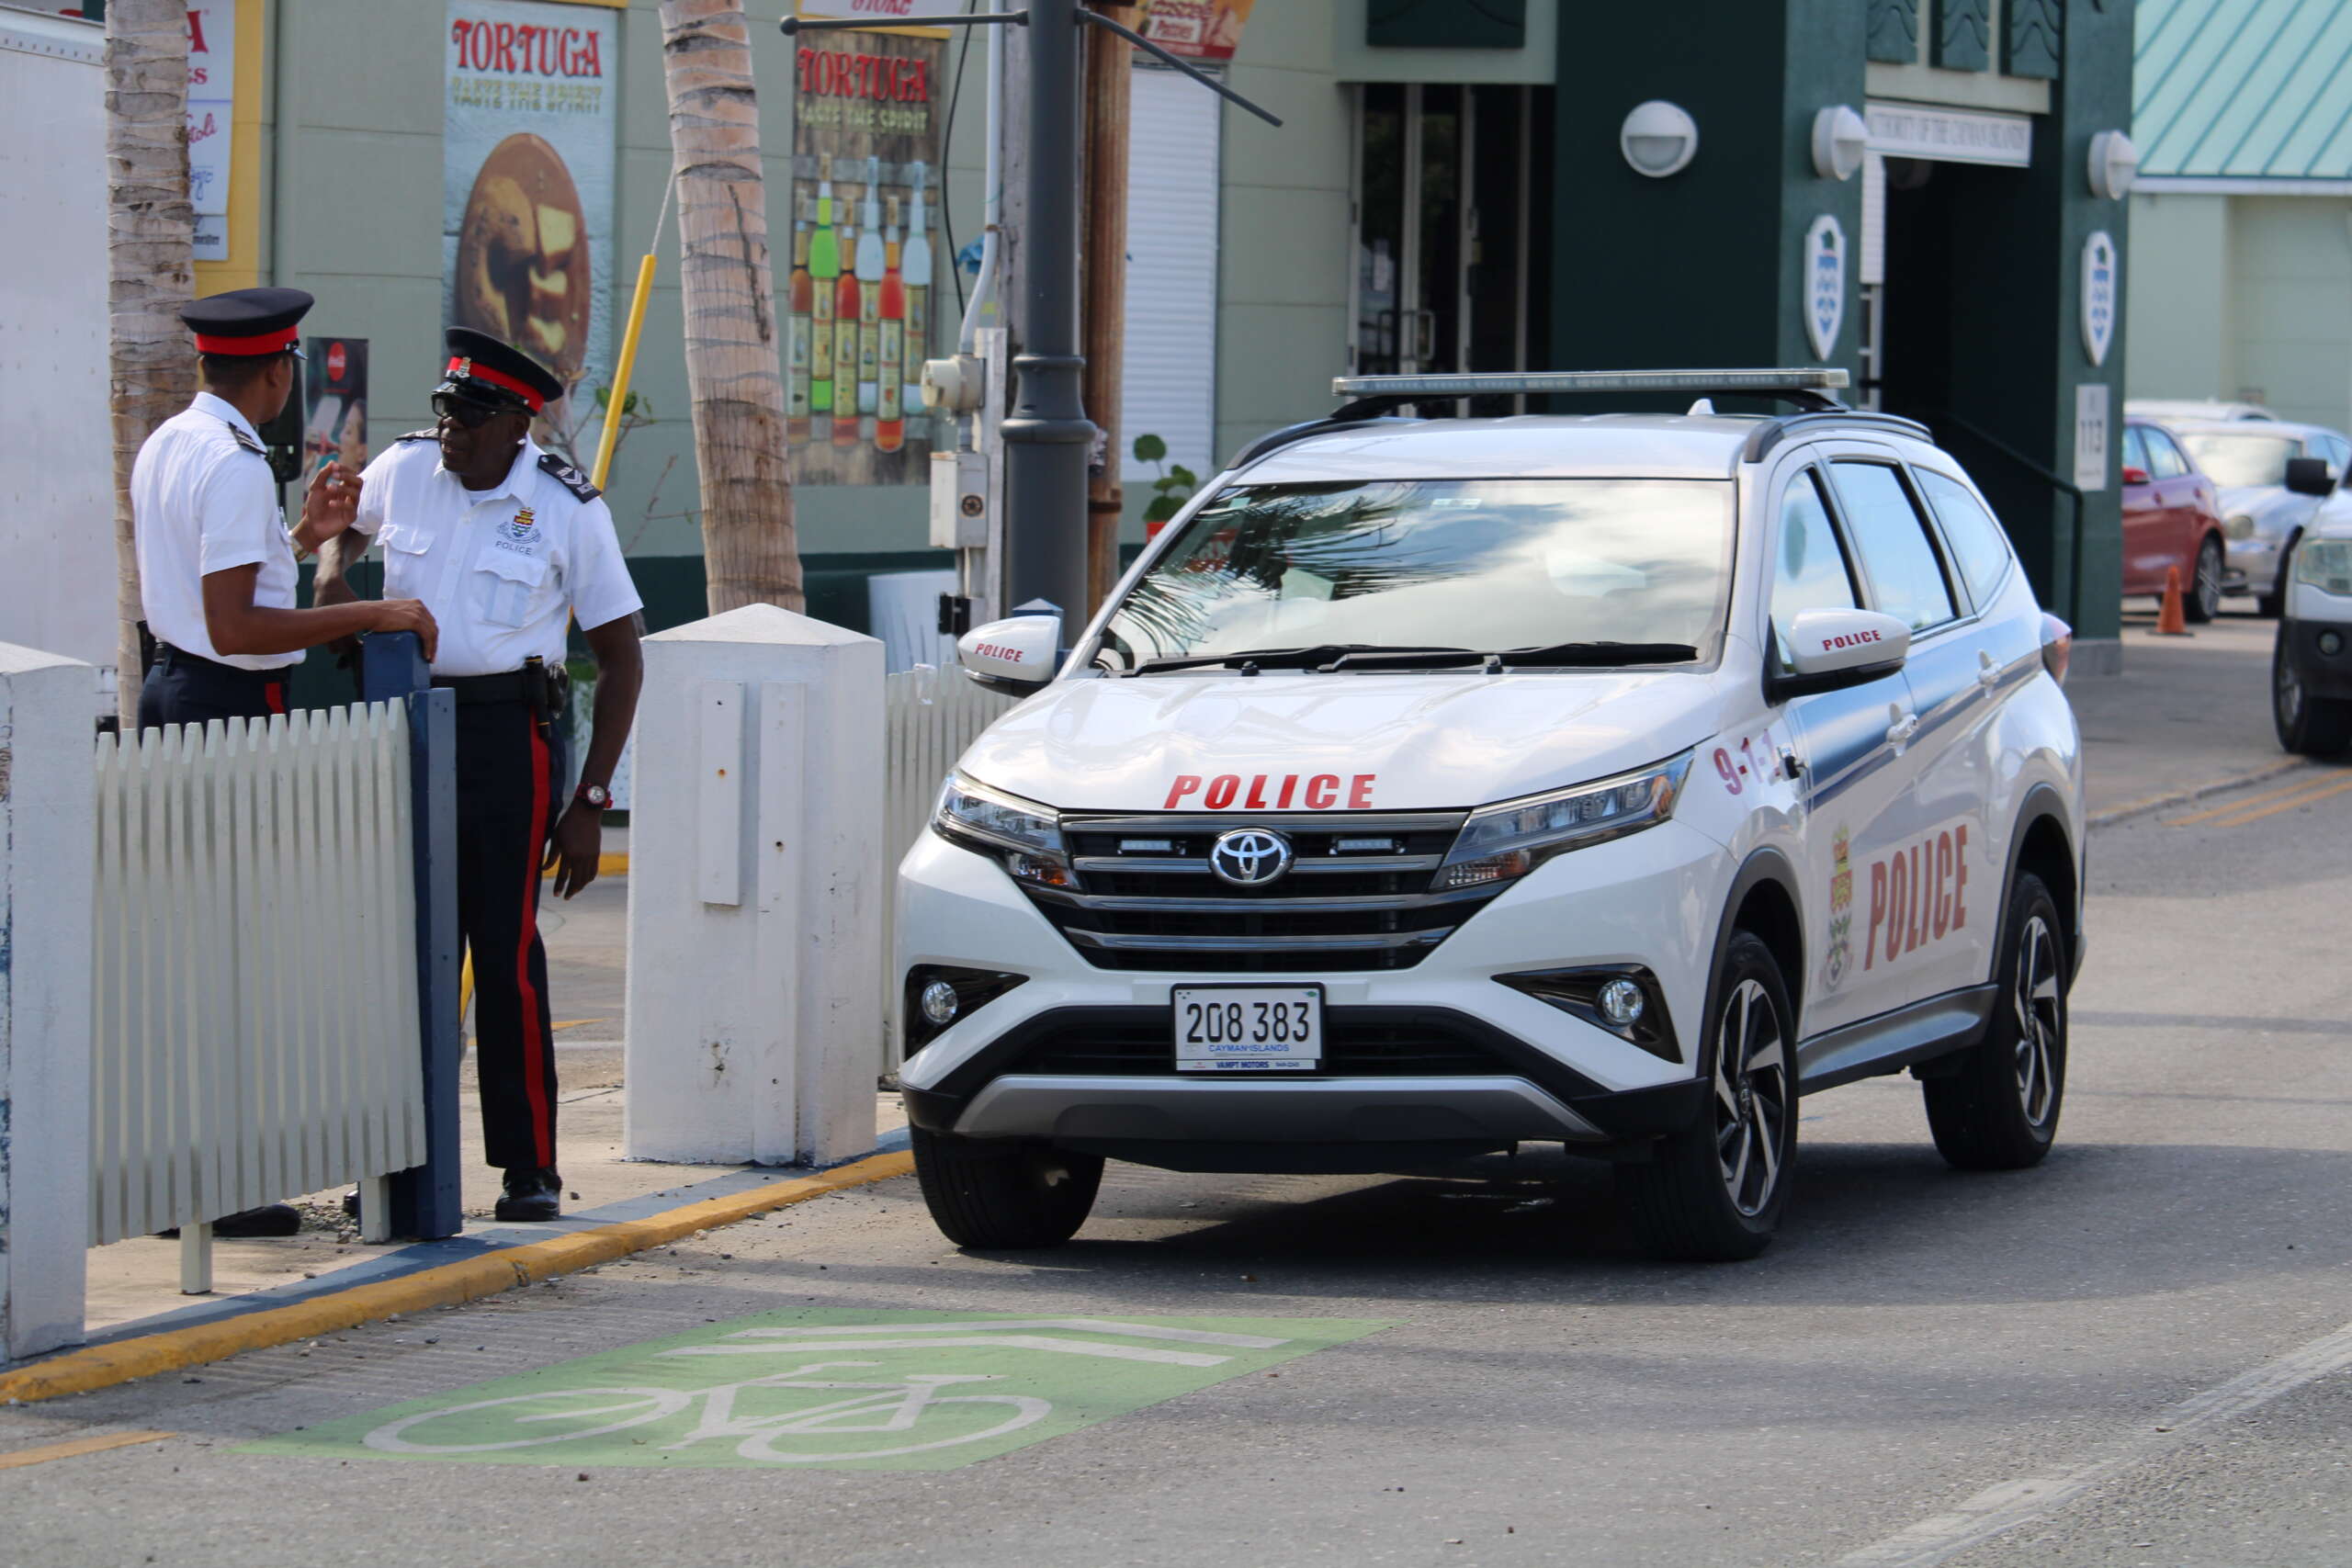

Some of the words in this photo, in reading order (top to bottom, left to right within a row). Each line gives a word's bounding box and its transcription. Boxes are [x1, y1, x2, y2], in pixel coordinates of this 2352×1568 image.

[451, 18, 603, 77] TORTUGA
[797, 47, 928, 102] TORTUGA
[495, 540, 532, 556] POLICE
[975, 643, 1024, 662] POLICE
[1822, 630, 1883, 651] POLICE
[1163, 774, 1376, 810] POLICE
[1864, 824, 1968, 971] POLICE
[1187, 1002, 1243, 1043] 208
[1252, 1001, 1309, 1043] 383
[1208, 1044, 1247, 1053] CAYMAN
[1249, 1043, 1290, 1052] ISLANDS
